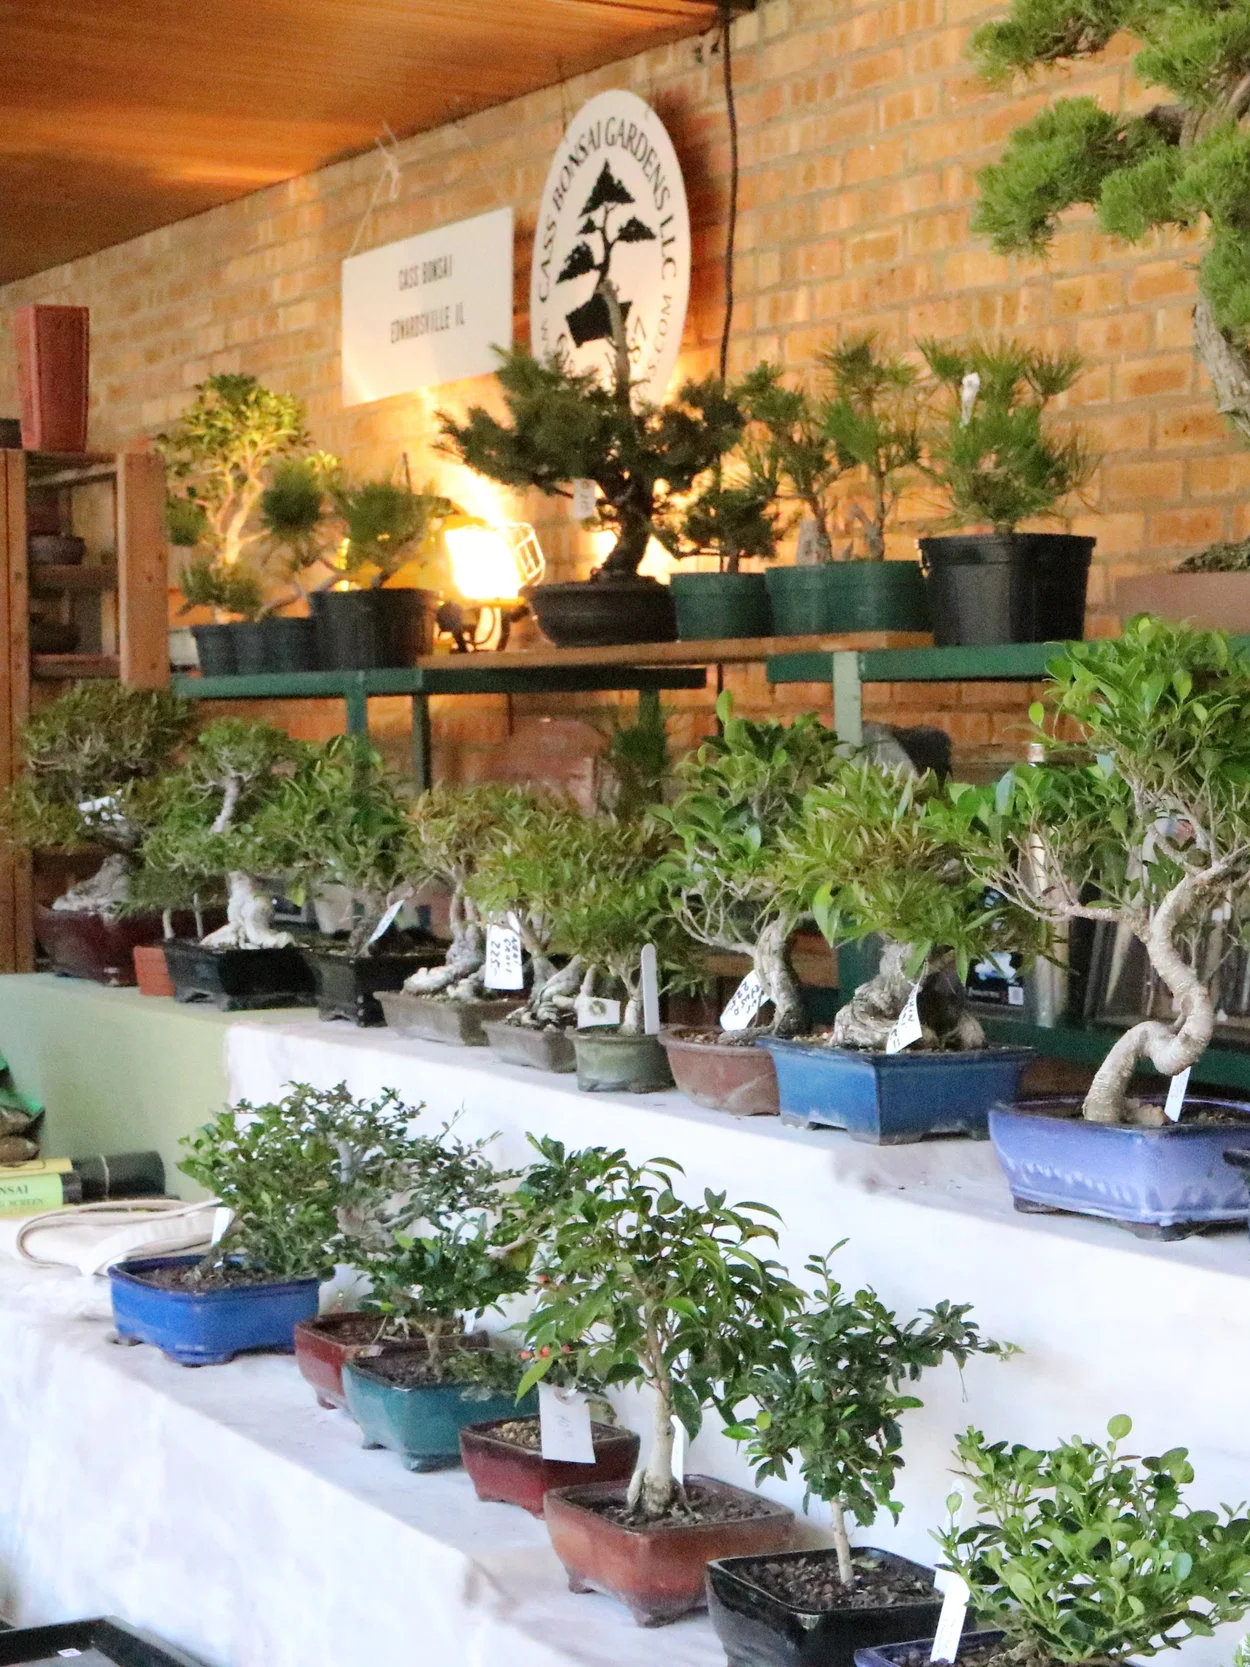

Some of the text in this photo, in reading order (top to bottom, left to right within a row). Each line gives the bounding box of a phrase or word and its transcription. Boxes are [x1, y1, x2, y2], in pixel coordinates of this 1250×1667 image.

[538, 115, 677, 303] CASS BONSAI GARDENS LLC
[398, 253, 454, 291] CASS BONSAI
[390, 305, 450, 344] EDWARDSVILLE
